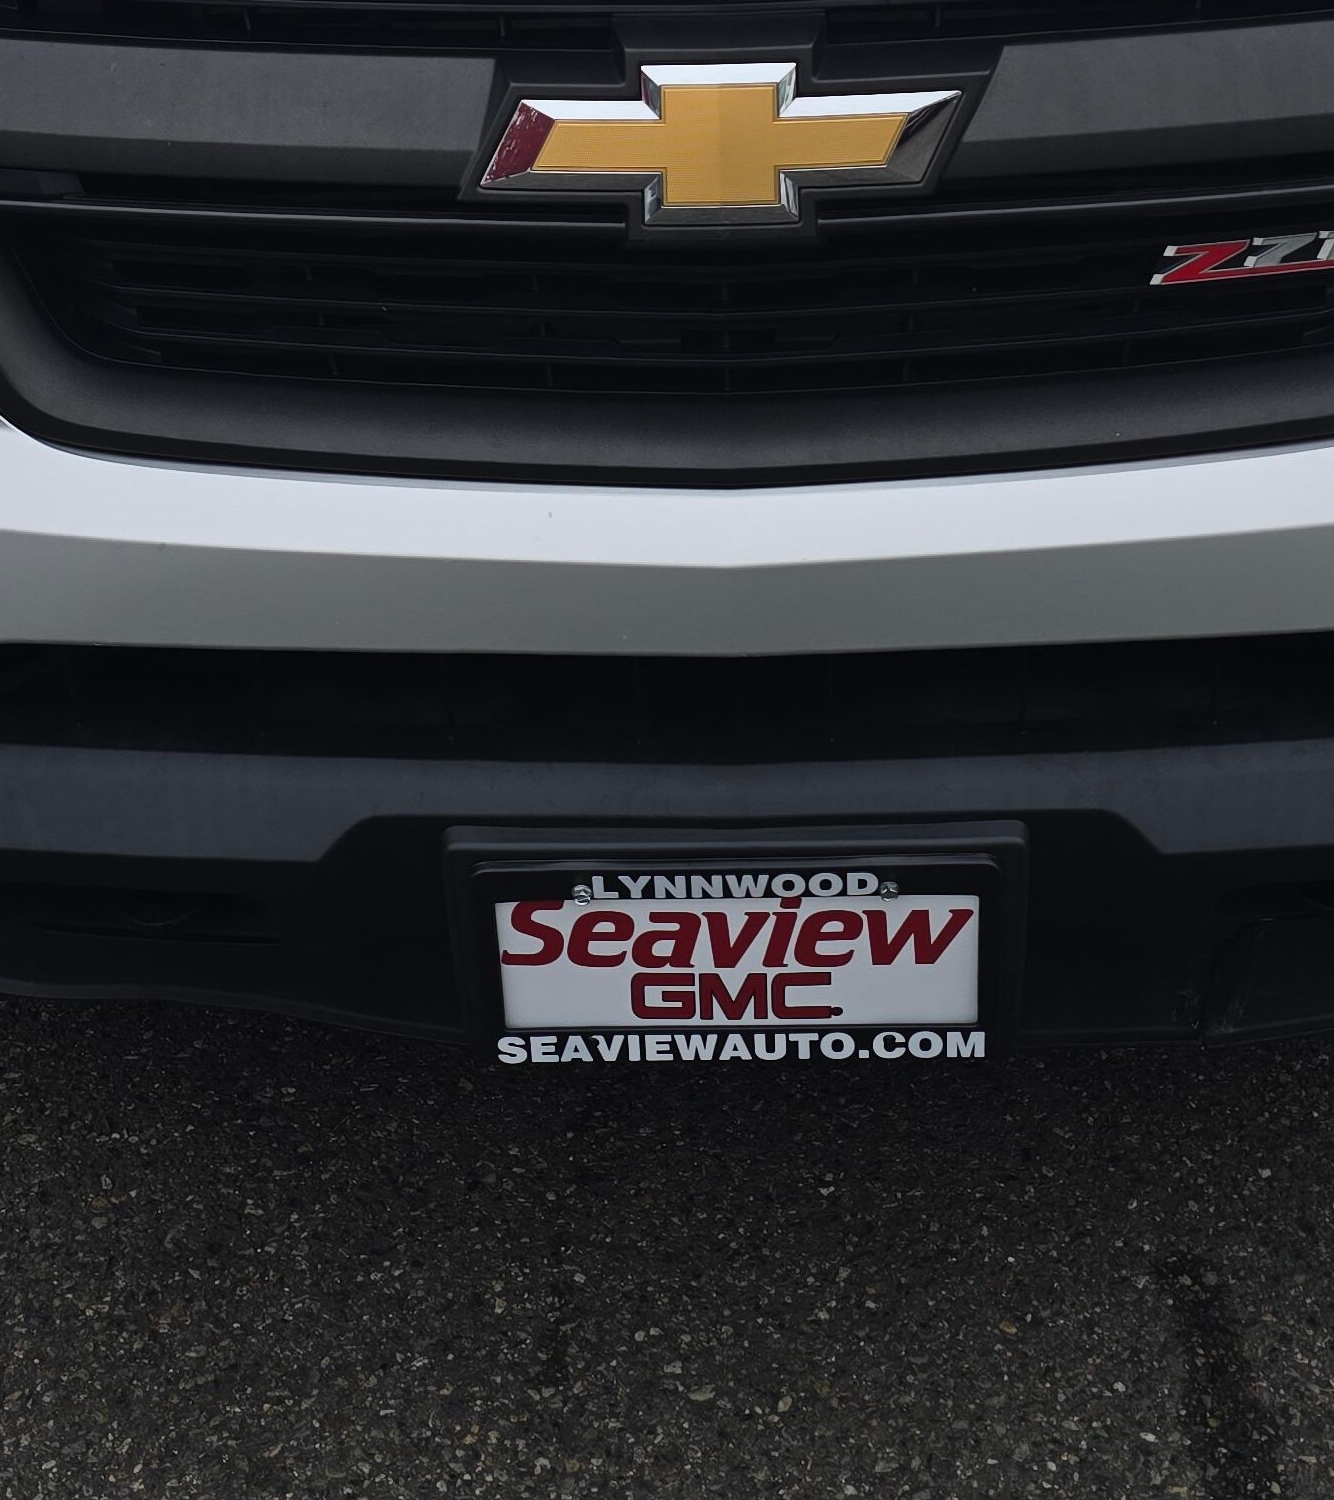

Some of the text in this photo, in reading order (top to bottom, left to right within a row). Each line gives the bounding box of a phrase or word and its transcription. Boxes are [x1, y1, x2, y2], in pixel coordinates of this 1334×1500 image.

[591, 872, 879, 898] LYNNWOOD
[501, 896, 975, 968] Seaview
[497, 1031, 987, 1064] SEAVIEWAUTO.COM
